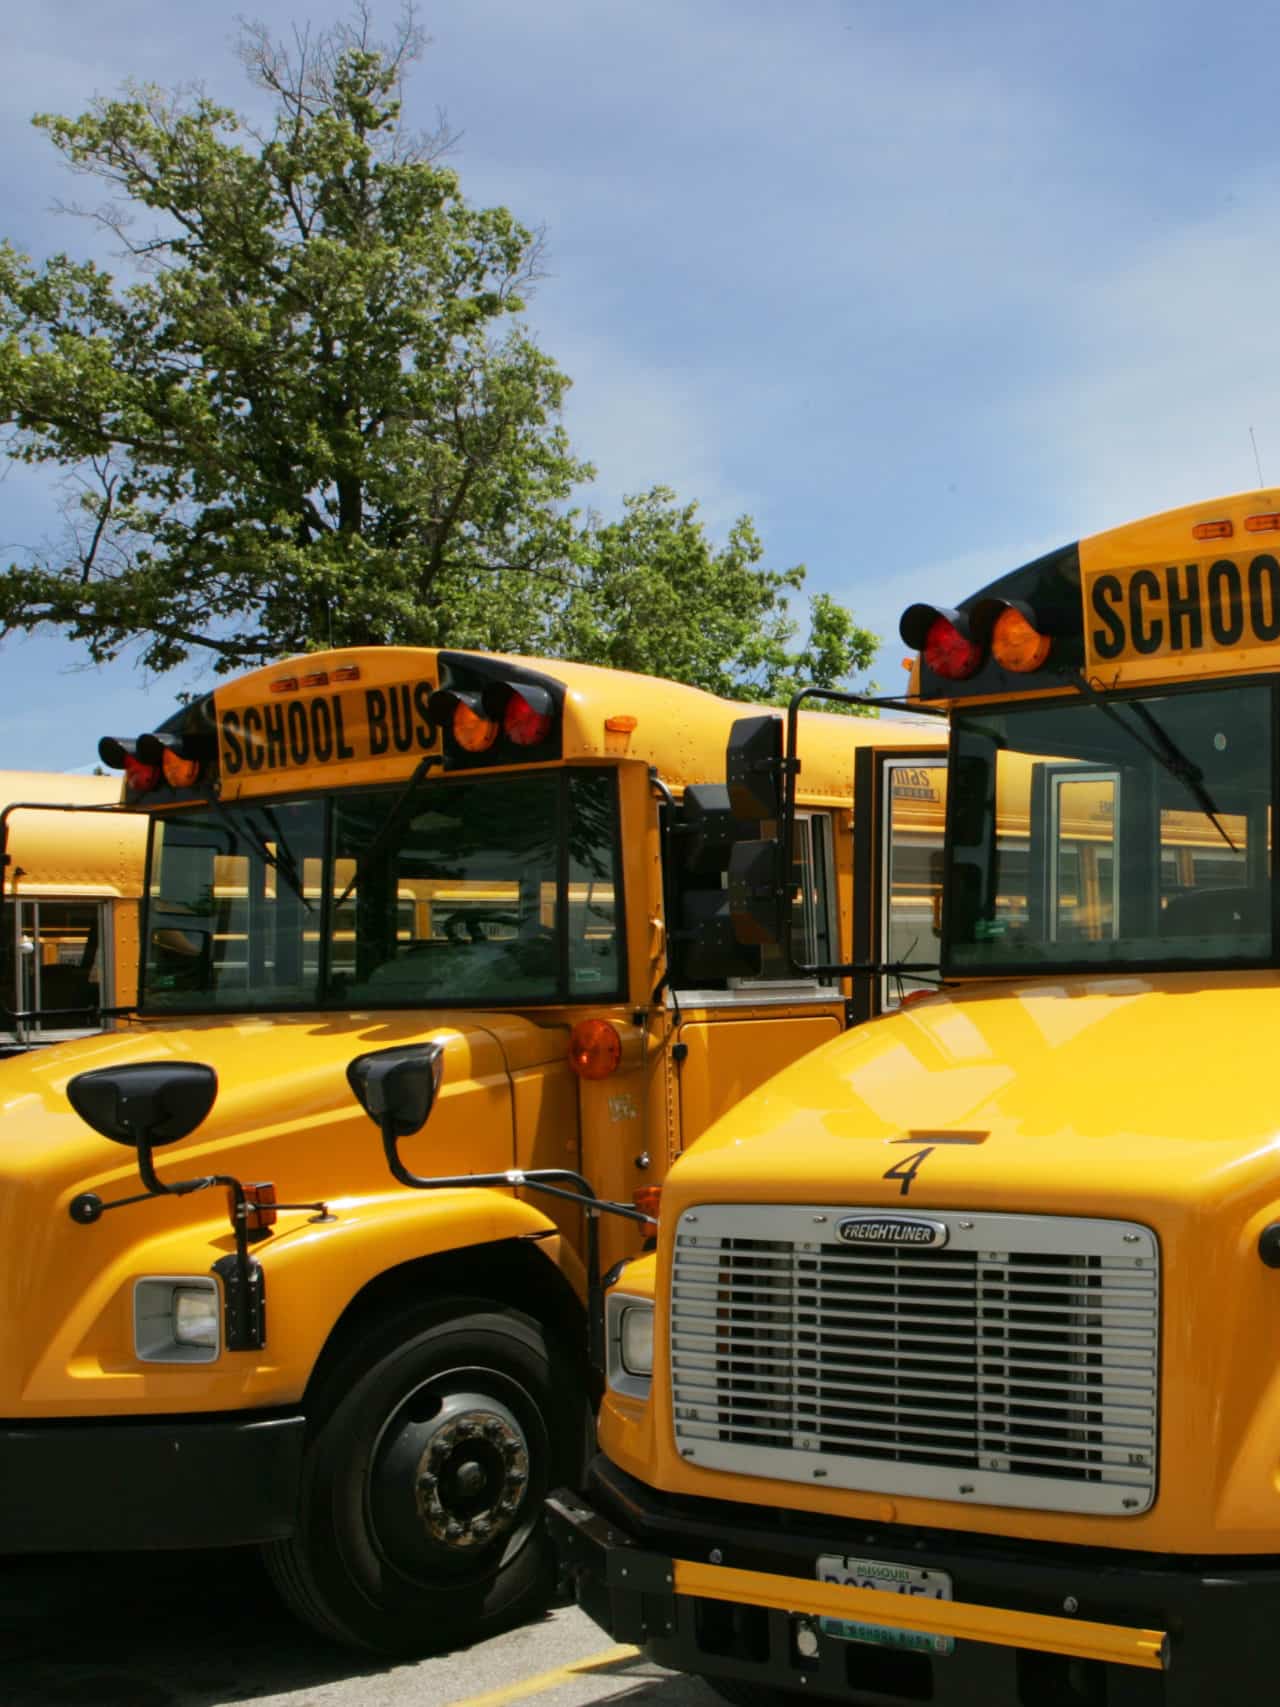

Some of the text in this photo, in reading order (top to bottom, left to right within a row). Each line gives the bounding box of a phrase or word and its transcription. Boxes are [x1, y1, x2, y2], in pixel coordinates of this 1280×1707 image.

[222, 681, 439, 775] SCHOOL BUS
[882, 1146, 936, 1196] 4
[843, 1223, 932, 1242] FREIGHTLINER
[856, 1564, 910, 1582] MISSOURI
